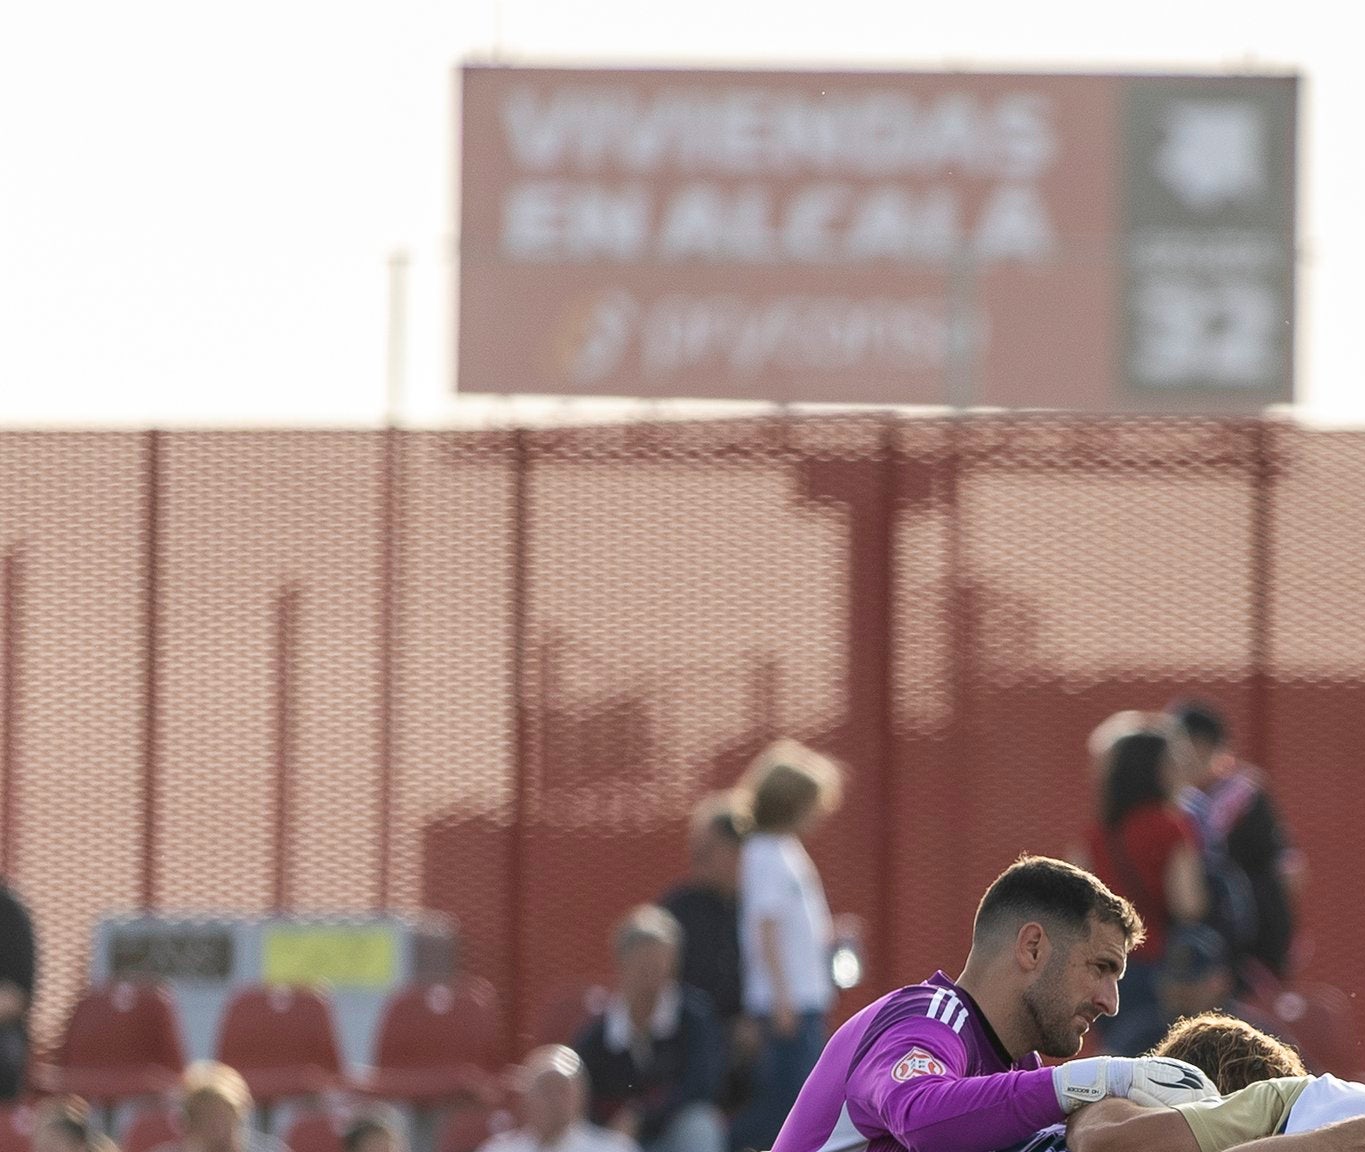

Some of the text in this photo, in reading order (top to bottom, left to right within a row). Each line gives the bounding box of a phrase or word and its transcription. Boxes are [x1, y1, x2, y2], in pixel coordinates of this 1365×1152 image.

[499, 85, 1059, 178] VIVIENDAS
[501, 181, 651, 262] EN
[1132, 283, 1276, 386] 32
